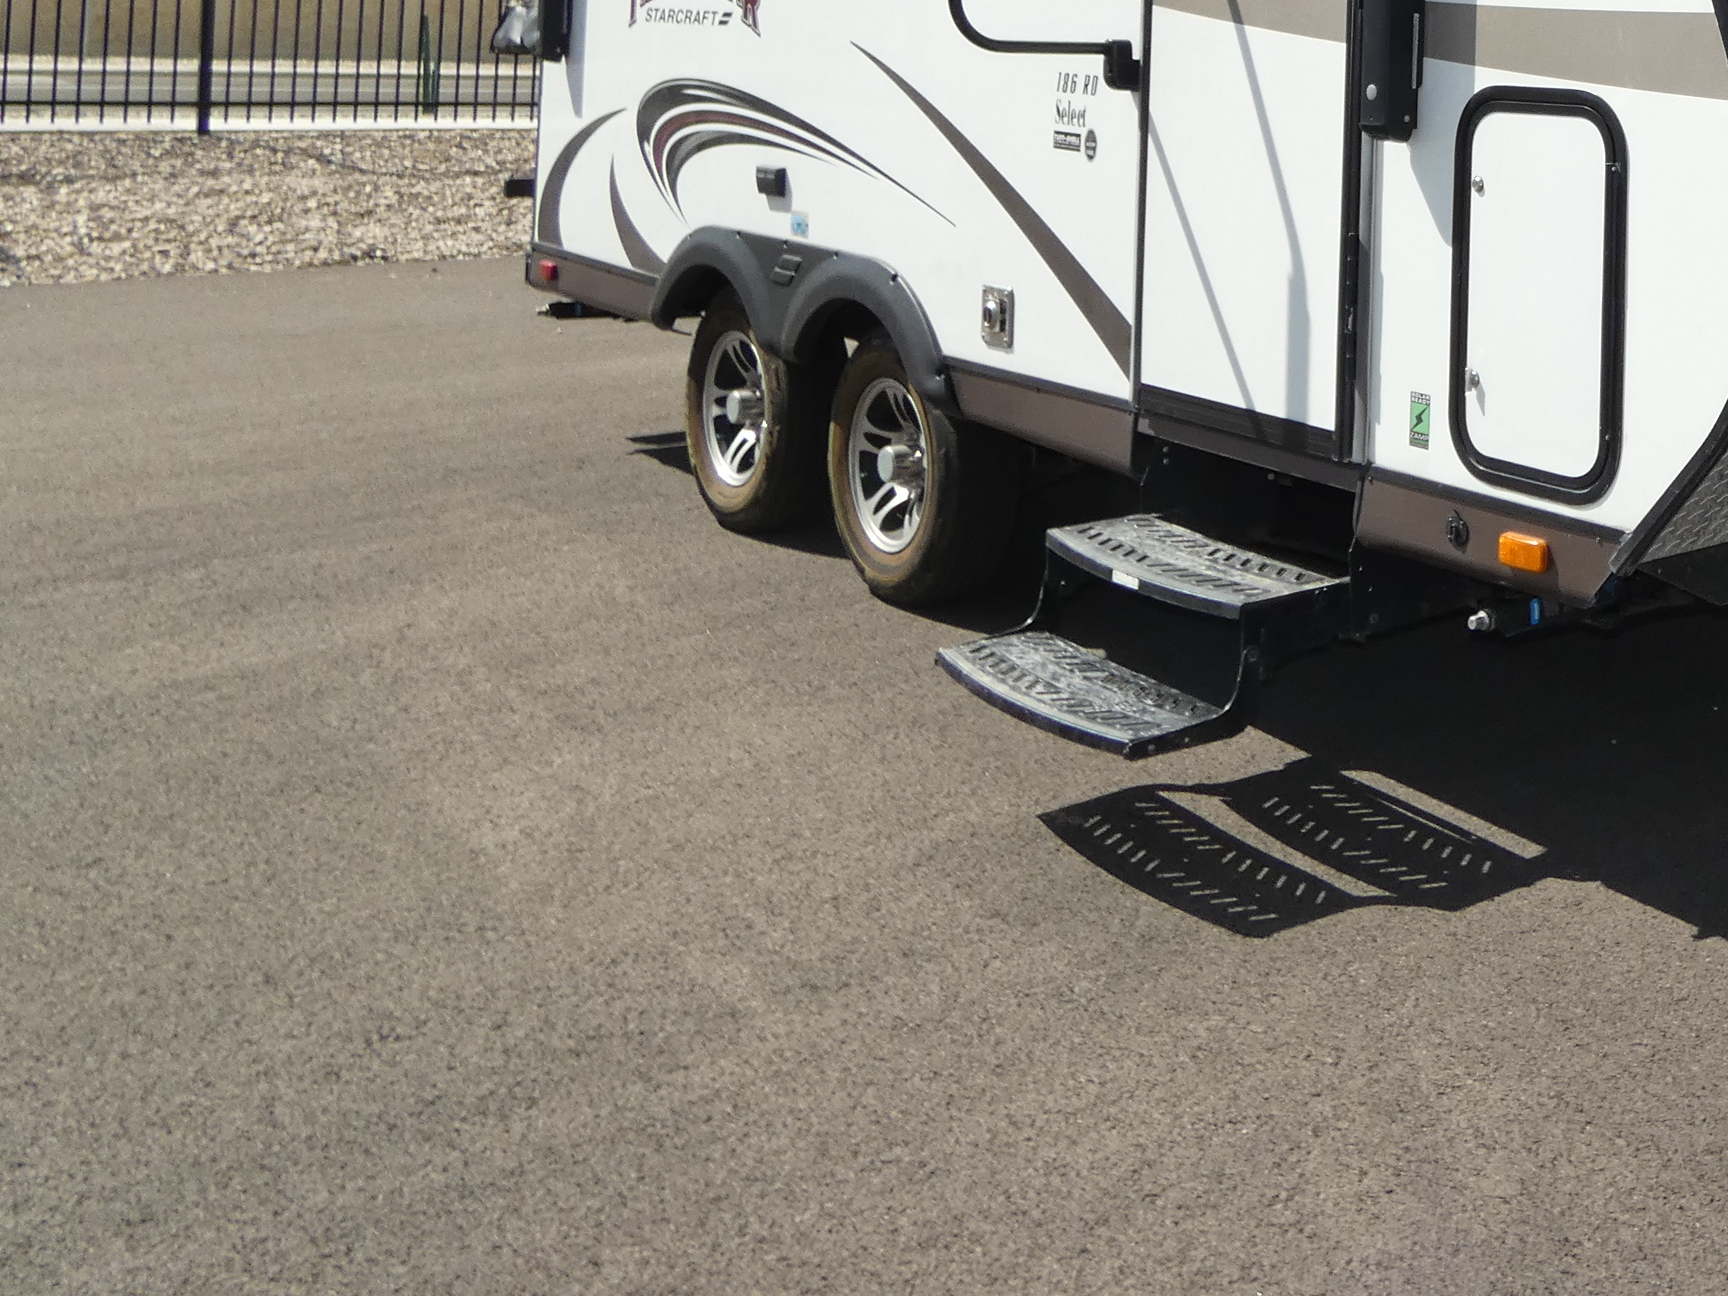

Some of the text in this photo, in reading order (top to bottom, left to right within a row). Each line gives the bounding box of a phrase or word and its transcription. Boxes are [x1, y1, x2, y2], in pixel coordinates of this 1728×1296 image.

[645, 7, 719, 26] STARCRAFT
[1056, 71, 1078, 94] 186
[1055, 99, 1086, 128] Select
